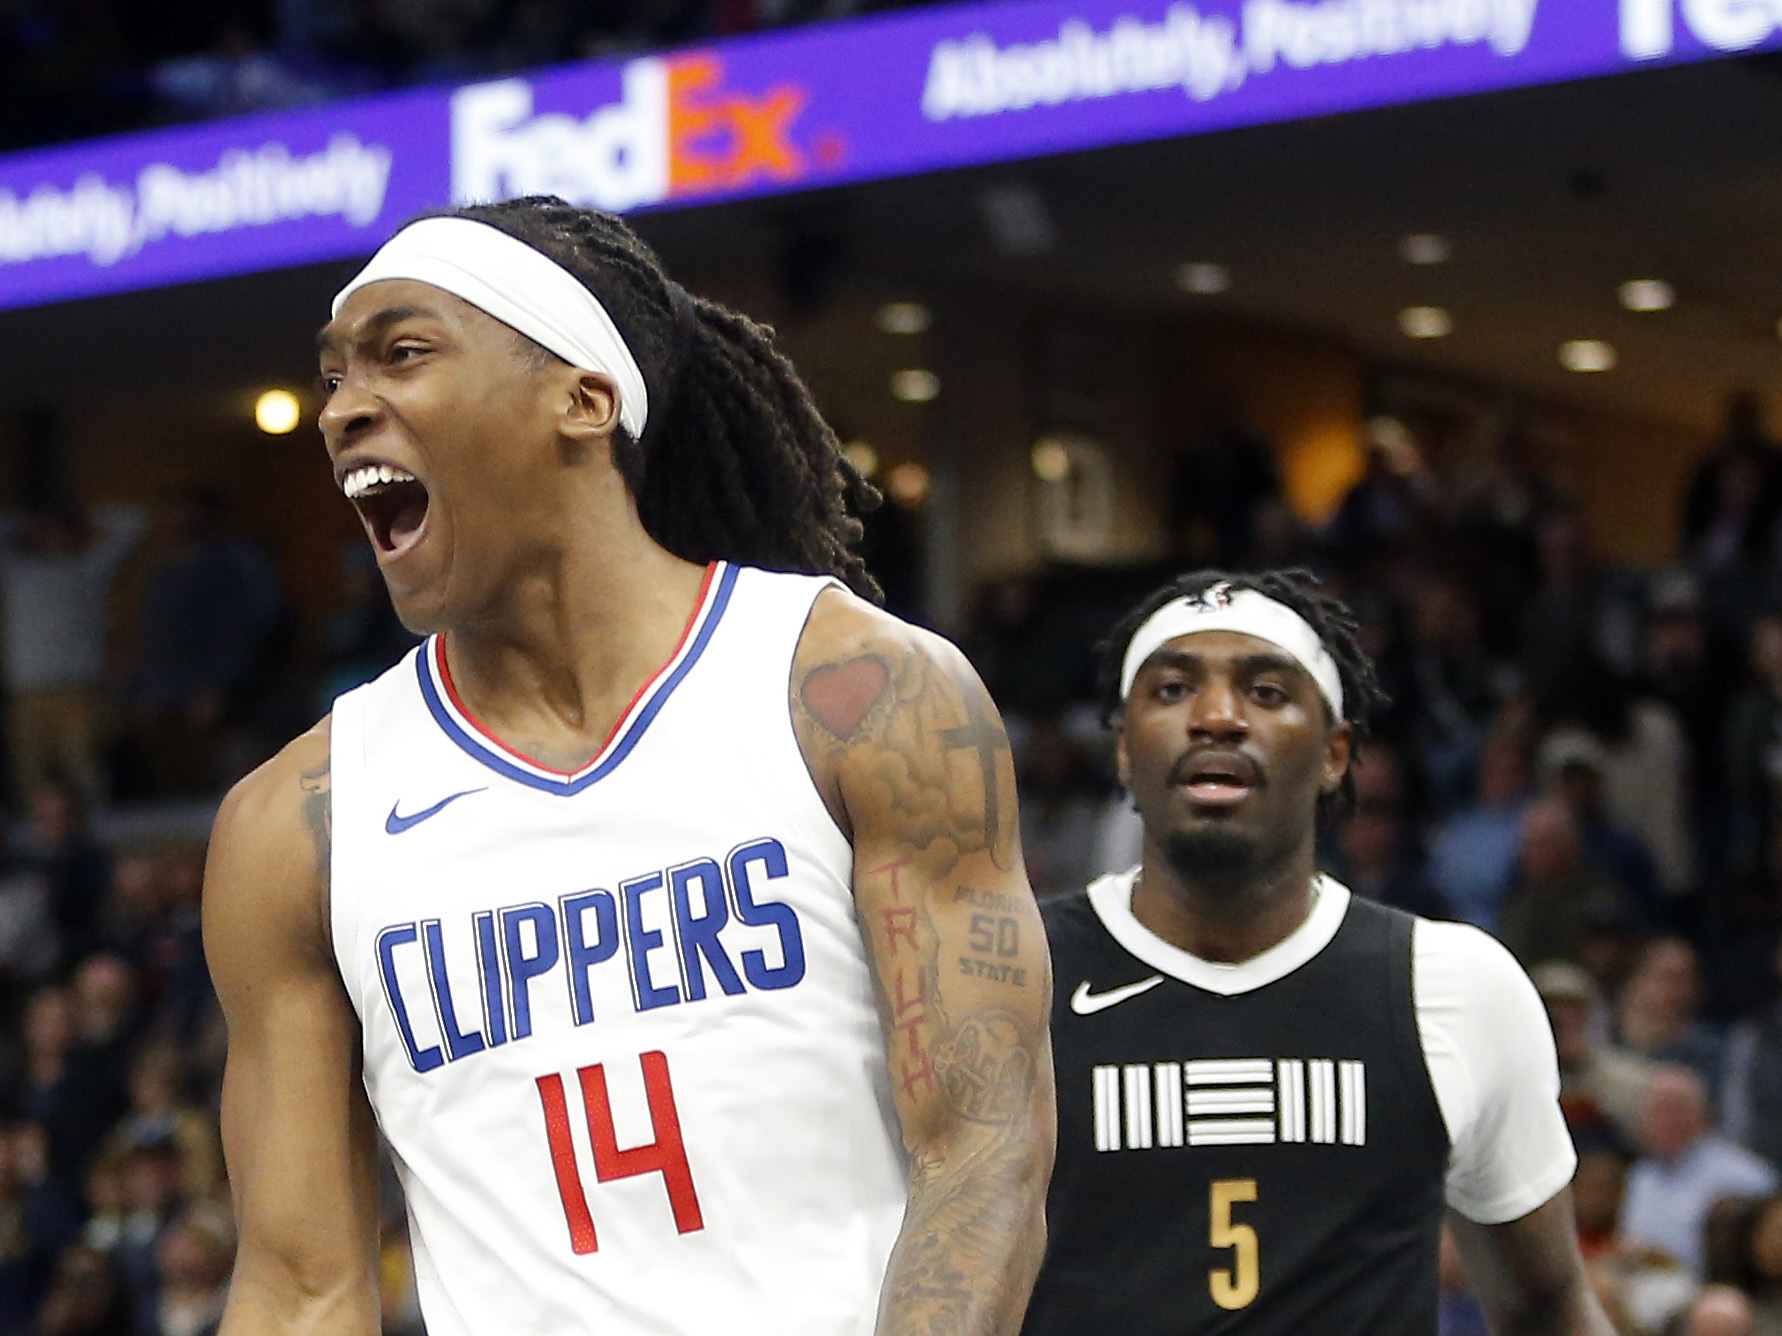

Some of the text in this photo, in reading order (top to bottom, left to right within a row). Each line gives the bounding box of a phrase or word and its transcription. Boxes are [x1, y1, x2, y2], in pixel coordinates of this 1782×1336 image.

[449, 52, 805, 212] FedEx
[375, 837, 806, 1074] CLIPPERS
[958, 957, 1026, 987] STATE
[535, 1049, 704, 1255] 14
[1208, 1178, 1260, 1310] 5
